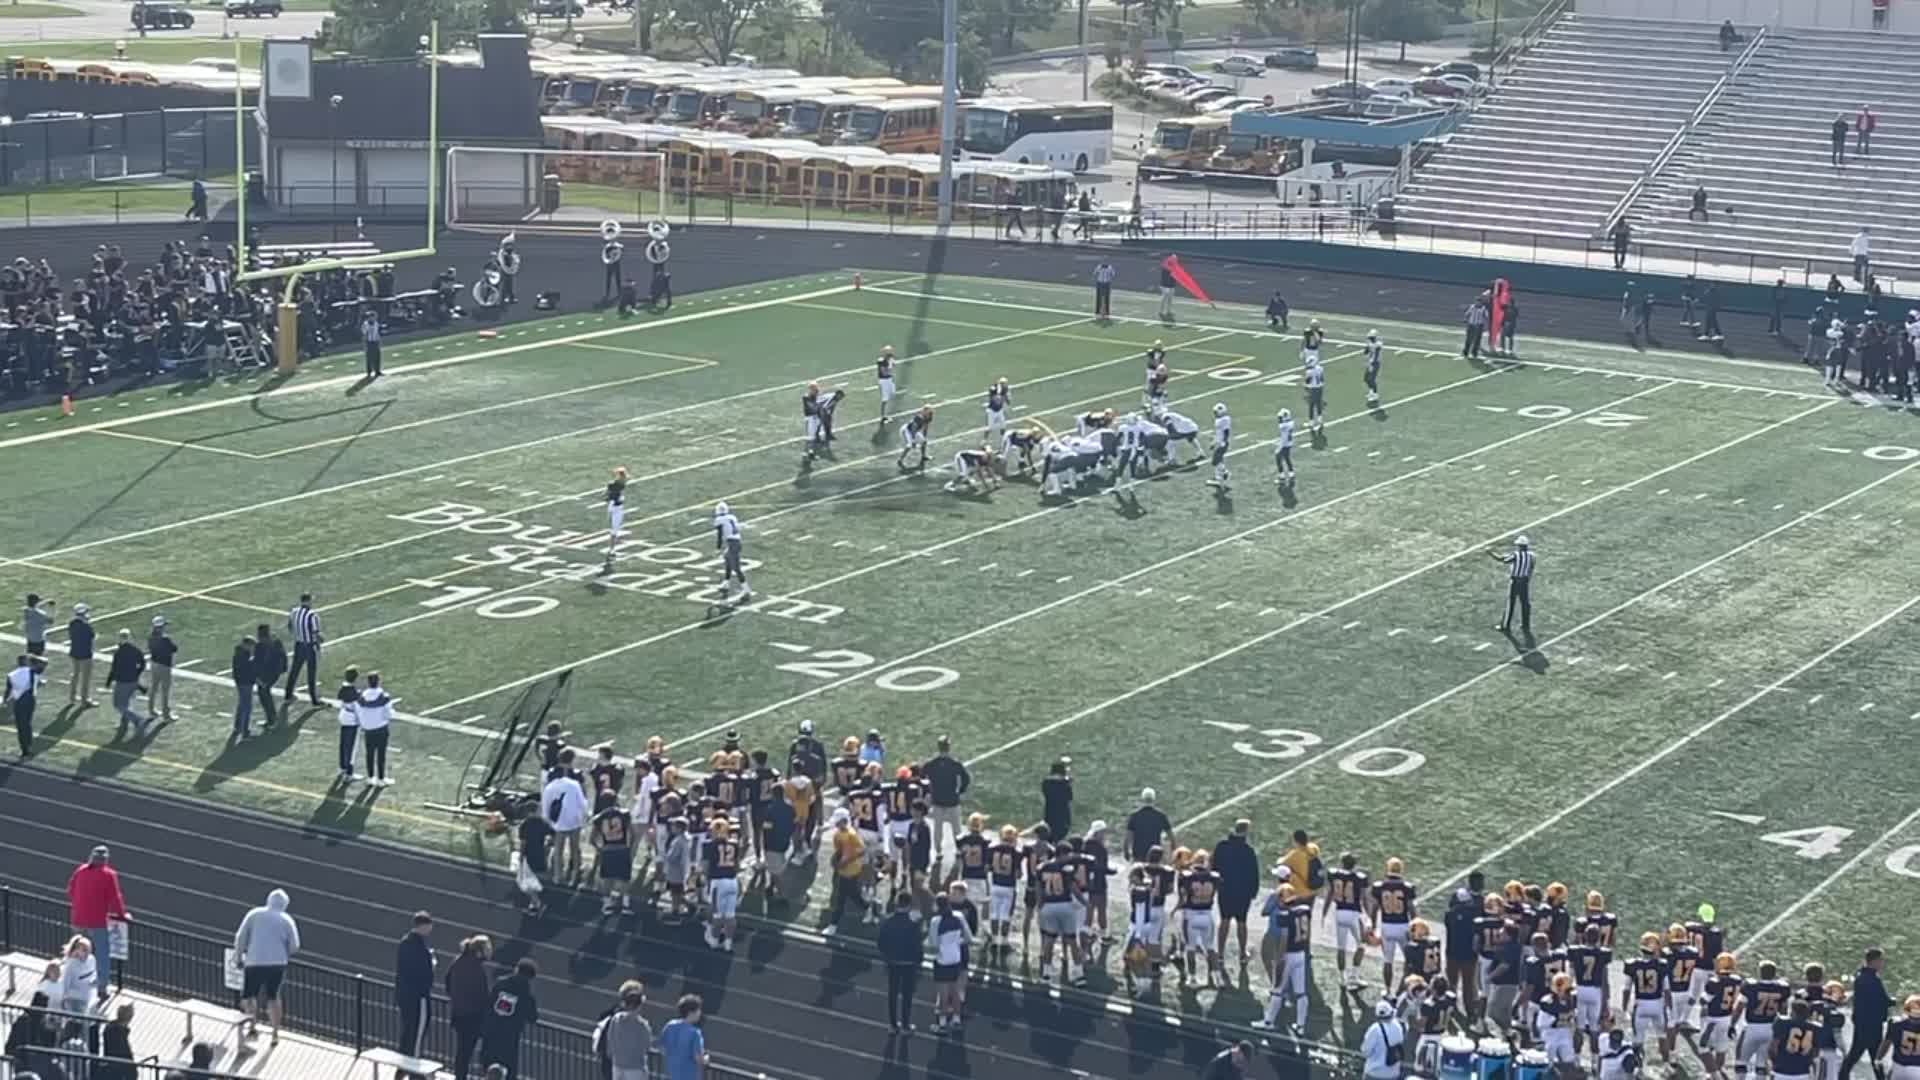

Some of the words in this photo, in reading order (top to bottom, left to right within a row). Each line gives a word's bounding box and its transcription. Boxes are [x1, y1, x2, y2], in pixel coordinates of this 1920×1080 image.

[452, 543, 847, 625] Stadium
[418, 584, 561, 619] 10
[774, 648, 961, 692] 20
[1231, 727, 1427, 777] 30
[717, 844, 736, 868] 12
[1582, 955, 1596, 982] 7
[1634, 968, 1658, 994] 13
[1785, 1026, 1814, 1057] 64
